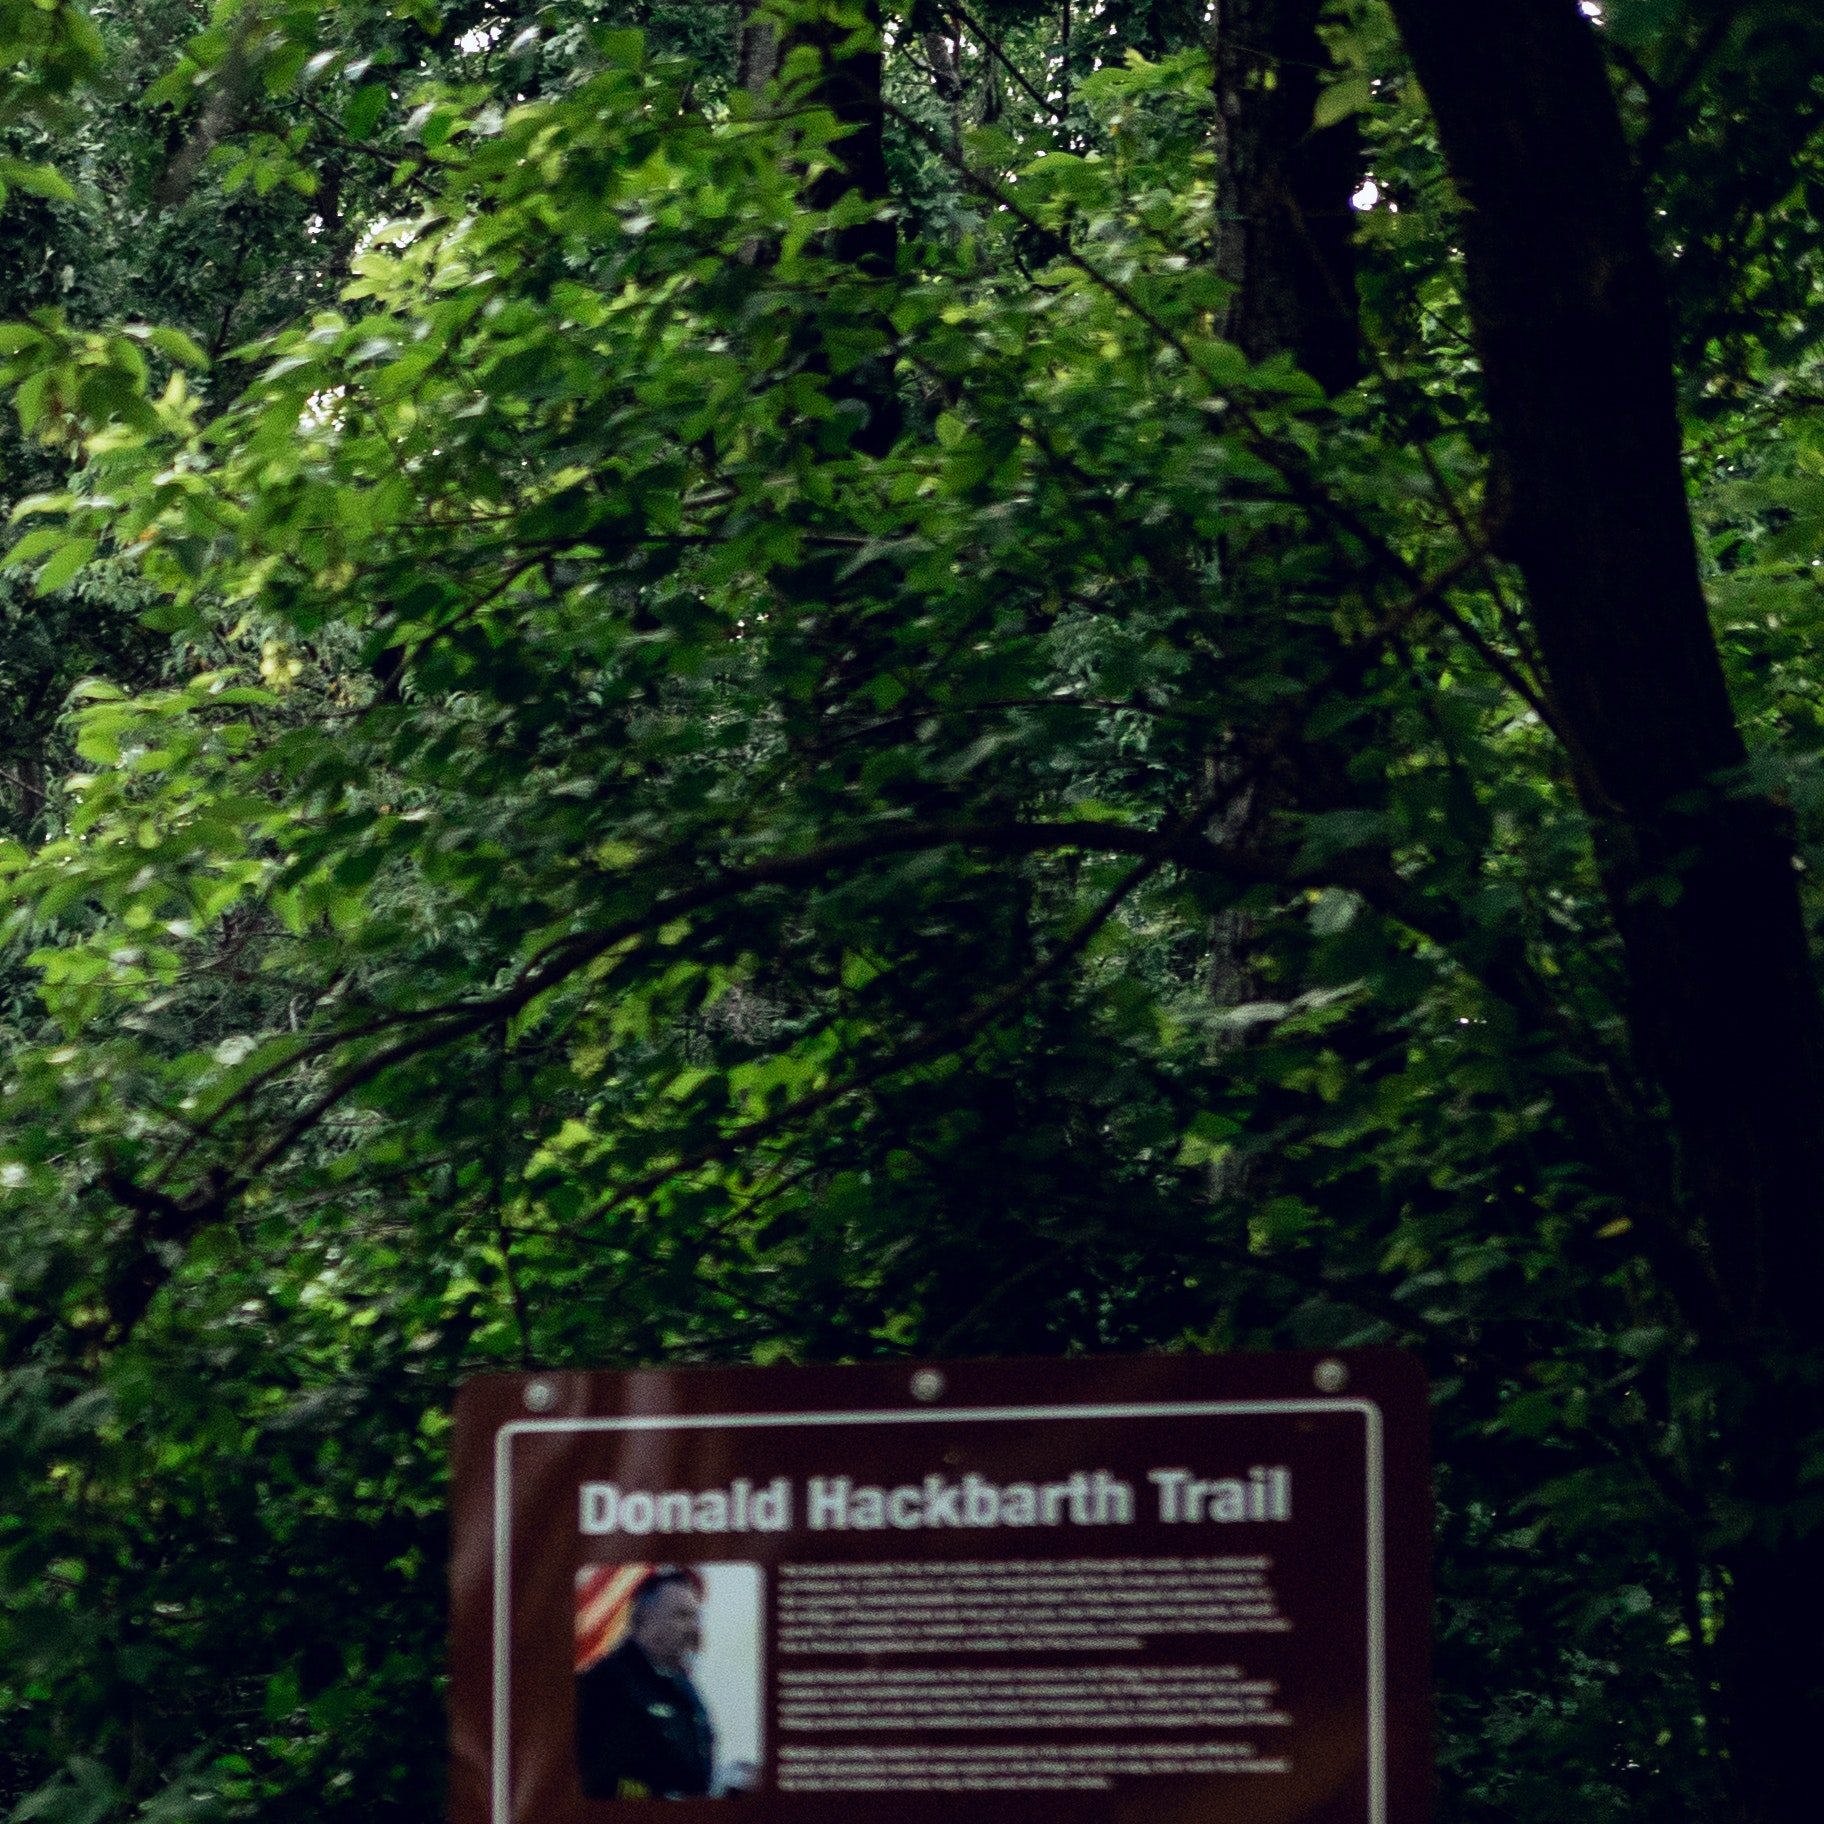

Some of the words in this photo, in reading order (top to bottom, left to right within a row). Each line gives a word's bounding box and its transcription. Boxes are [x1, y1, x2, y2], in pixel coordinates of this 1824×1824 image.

[578, 1477, 792, 1535] Donald
[806, 1470, 1136, 1531] Hackbarth
[1147, 1465, 1291, 1524] Trail
